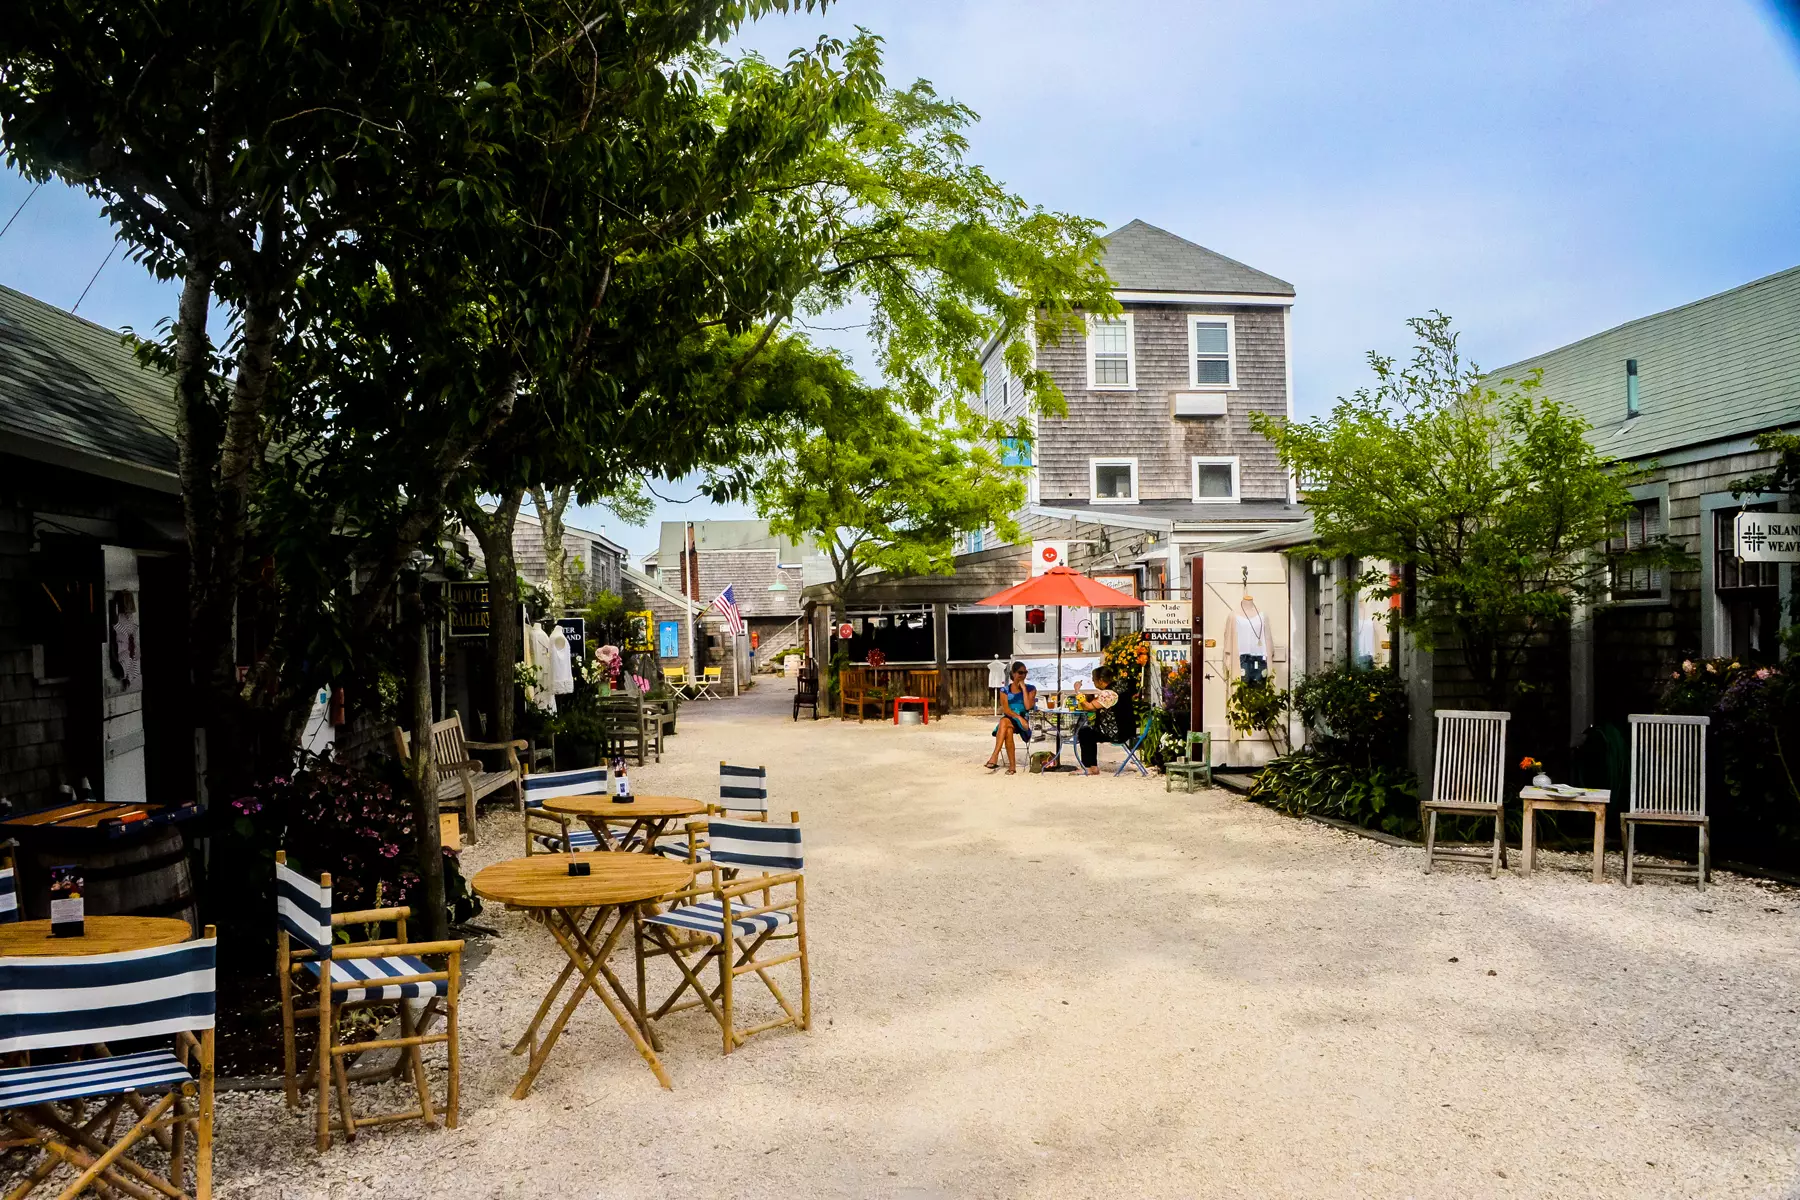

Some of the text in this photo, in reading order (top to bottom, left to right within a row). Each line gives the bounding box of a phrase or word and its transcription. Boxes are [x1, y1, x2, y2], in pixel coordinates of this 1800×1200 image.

[1768, 525, 1800, 535] ISLAN
[1161, 603, 1180, 611] Made
[563, 626, 576, 634] TER
[1151, 632, 1191, 640] BAKELITE
[1156, 649, 1187, 662] OPEN
